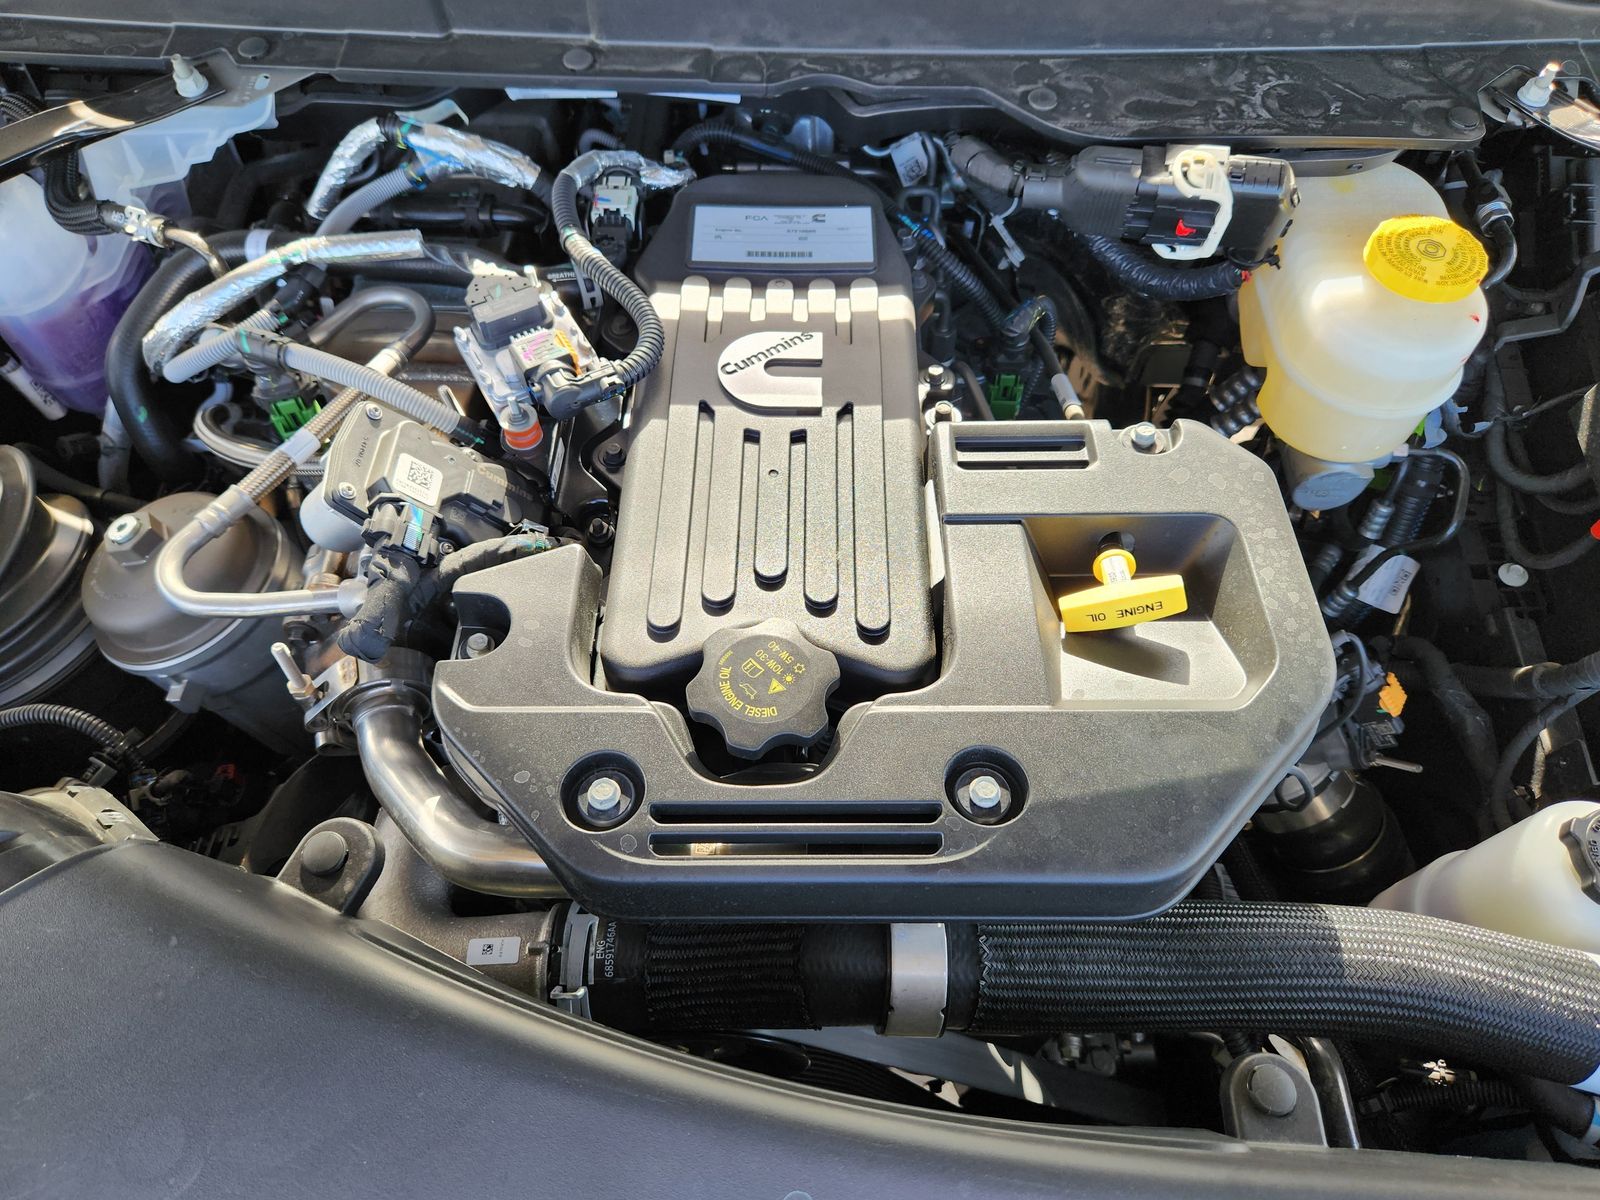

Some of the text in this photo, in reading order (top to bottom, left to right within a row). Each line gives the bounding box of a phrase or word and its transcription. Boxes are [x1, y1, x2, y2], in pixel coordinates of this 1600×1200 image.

[720, 331, 814, 375] Cummins
[1086, 601, 1163, 622] ENGINE OIL
[719, 666, 732, 679] OIL
[719, 680, 744, 710] ENGINE
[744, 704, 778, 718] DIESEL
[596, 940, 606, 959] ENG
